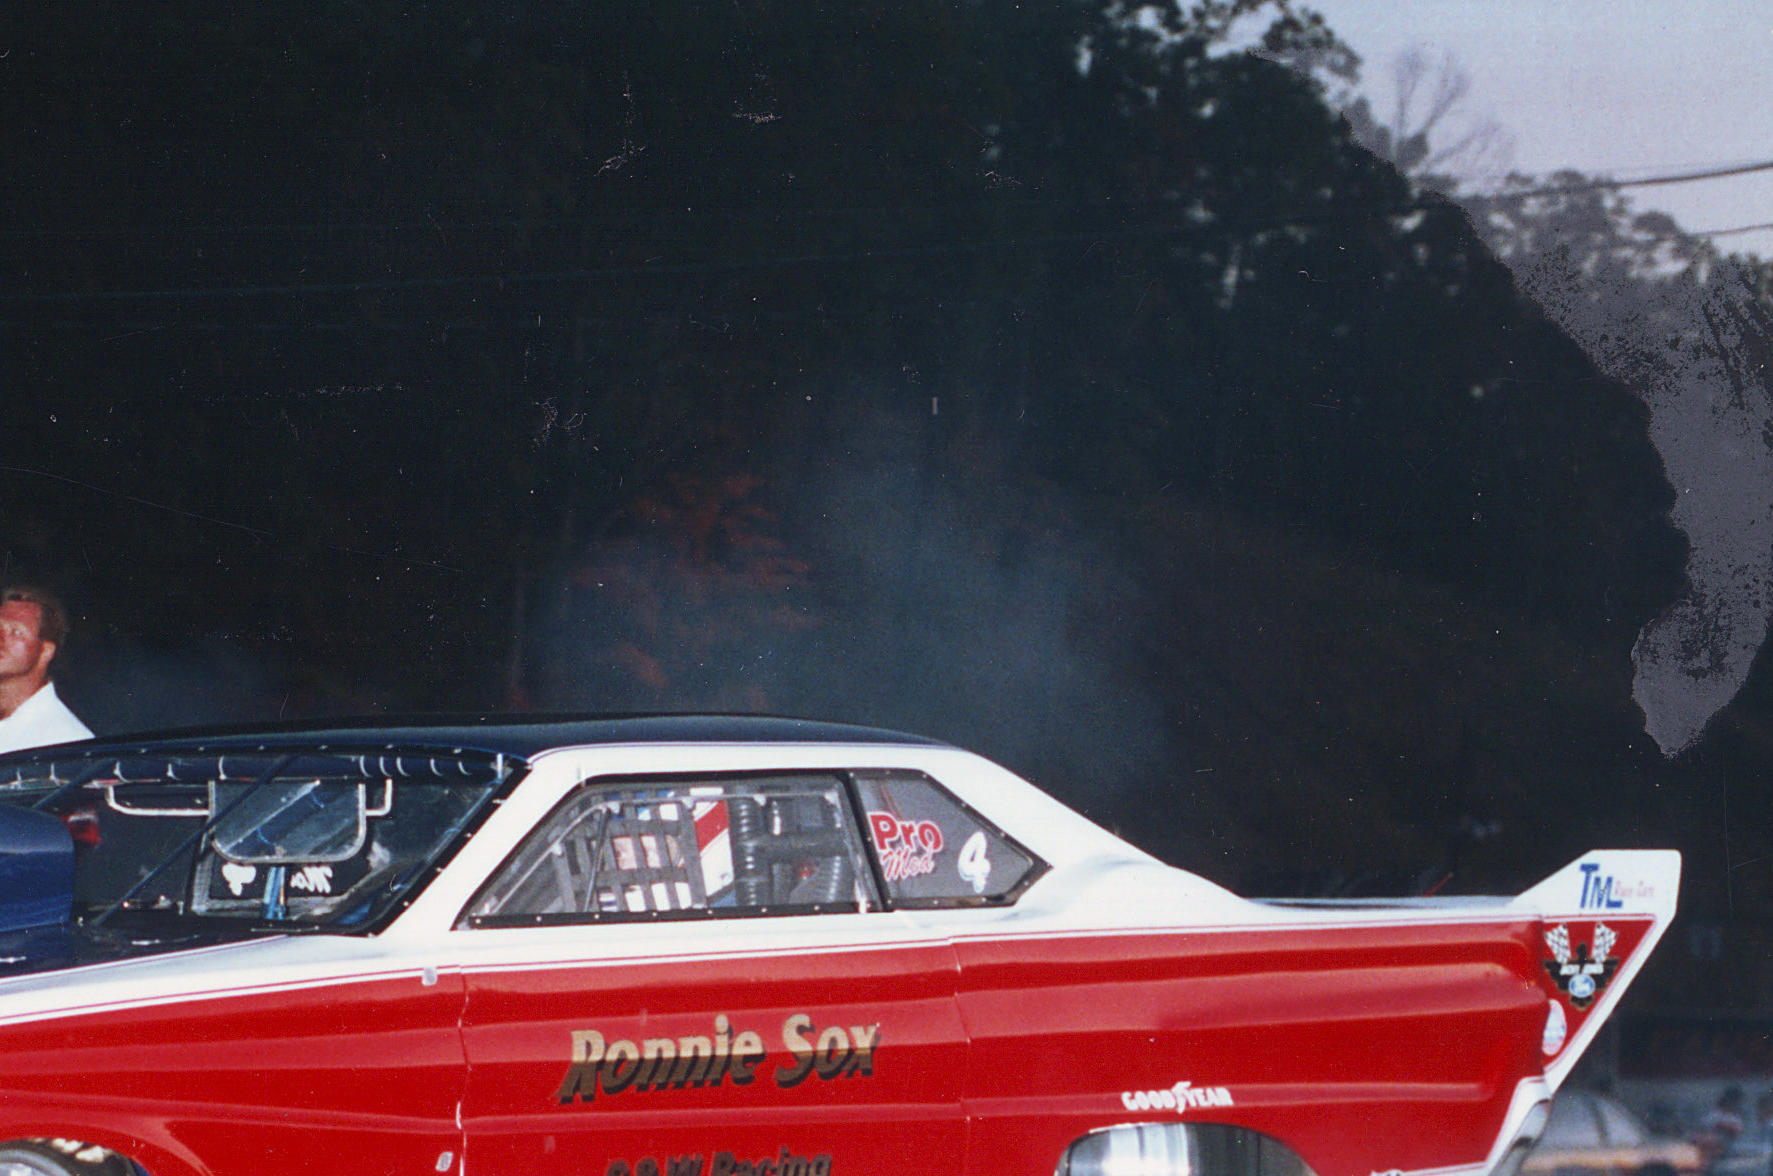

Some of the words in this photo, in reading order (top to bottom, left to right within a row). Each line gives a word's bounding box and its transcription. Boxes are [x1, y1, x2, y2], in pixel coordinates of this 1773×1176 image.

[868, 812, 943, 853] Pro
[958, 831, 991, 893] 4
[553, 1013, 766, 1104] Ronnie
[775, 1013, 881, 1088] Sox
[1121, 1081, 1234, 1114] GOODYEAR
